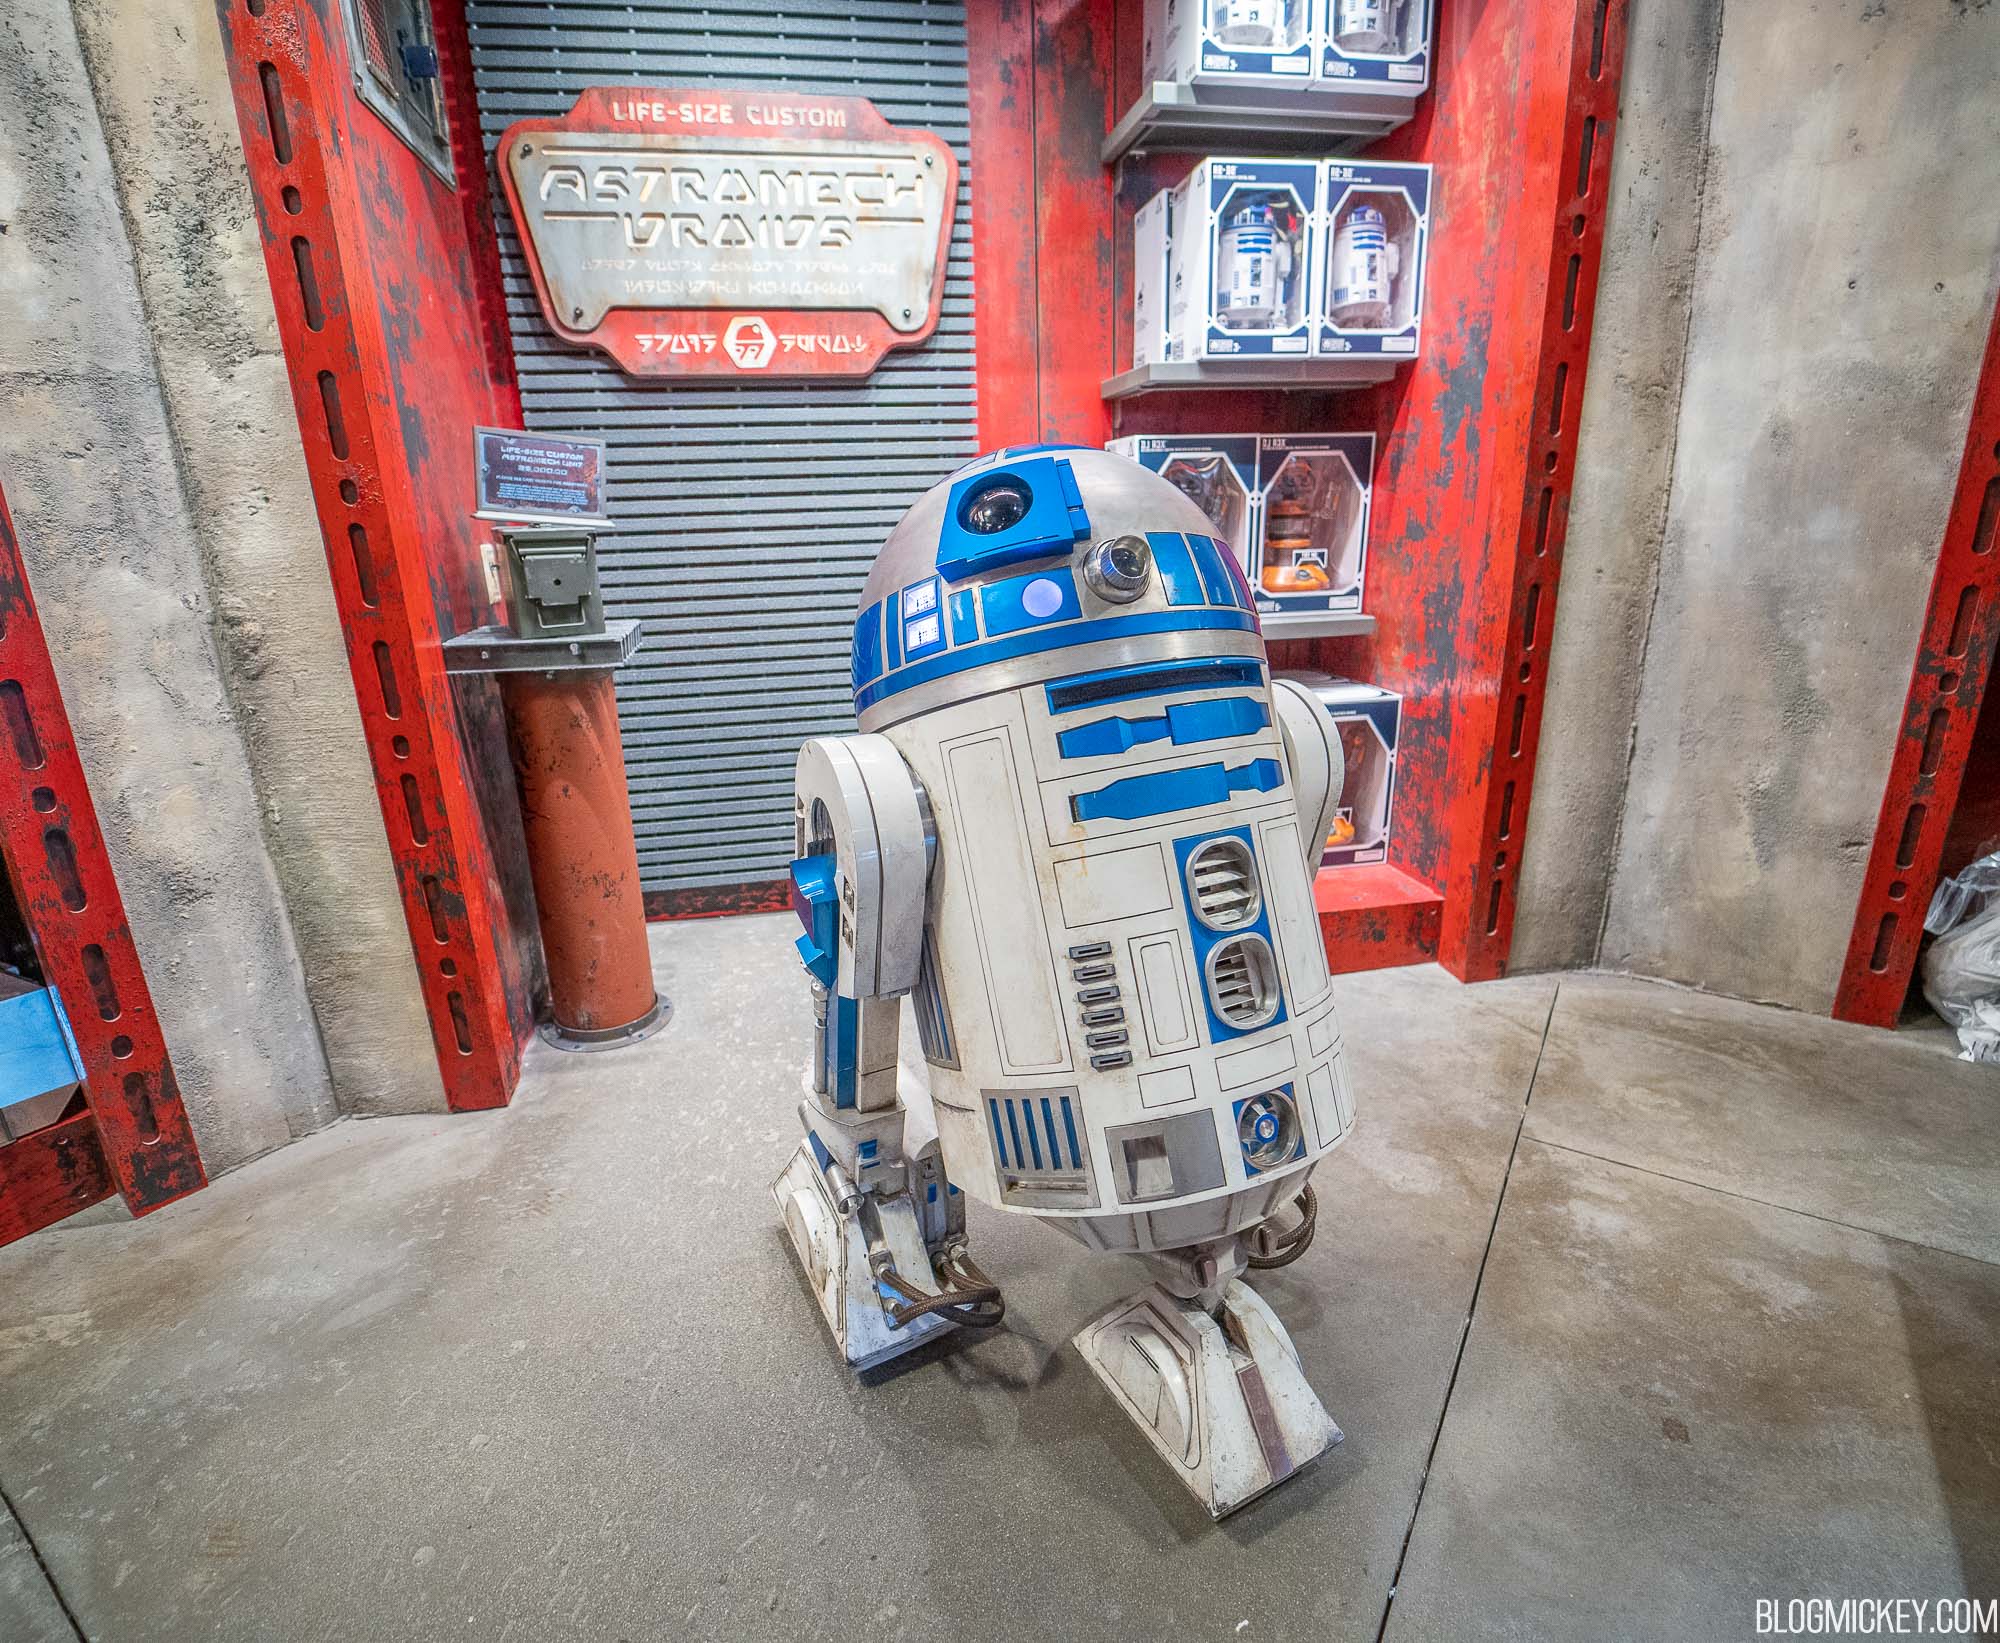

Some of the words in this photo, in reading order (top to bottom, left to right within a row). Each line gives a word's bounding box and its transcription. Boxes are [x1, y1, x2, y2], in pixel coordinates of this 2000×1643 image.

[612, 101, 734, 124] LIFE-SIZE
[746, 104, 847, 127] CUSTOM
[501, 446, 544, 456] LIFE-SIZE
[546, 450, 584, 460] CUSTOM
